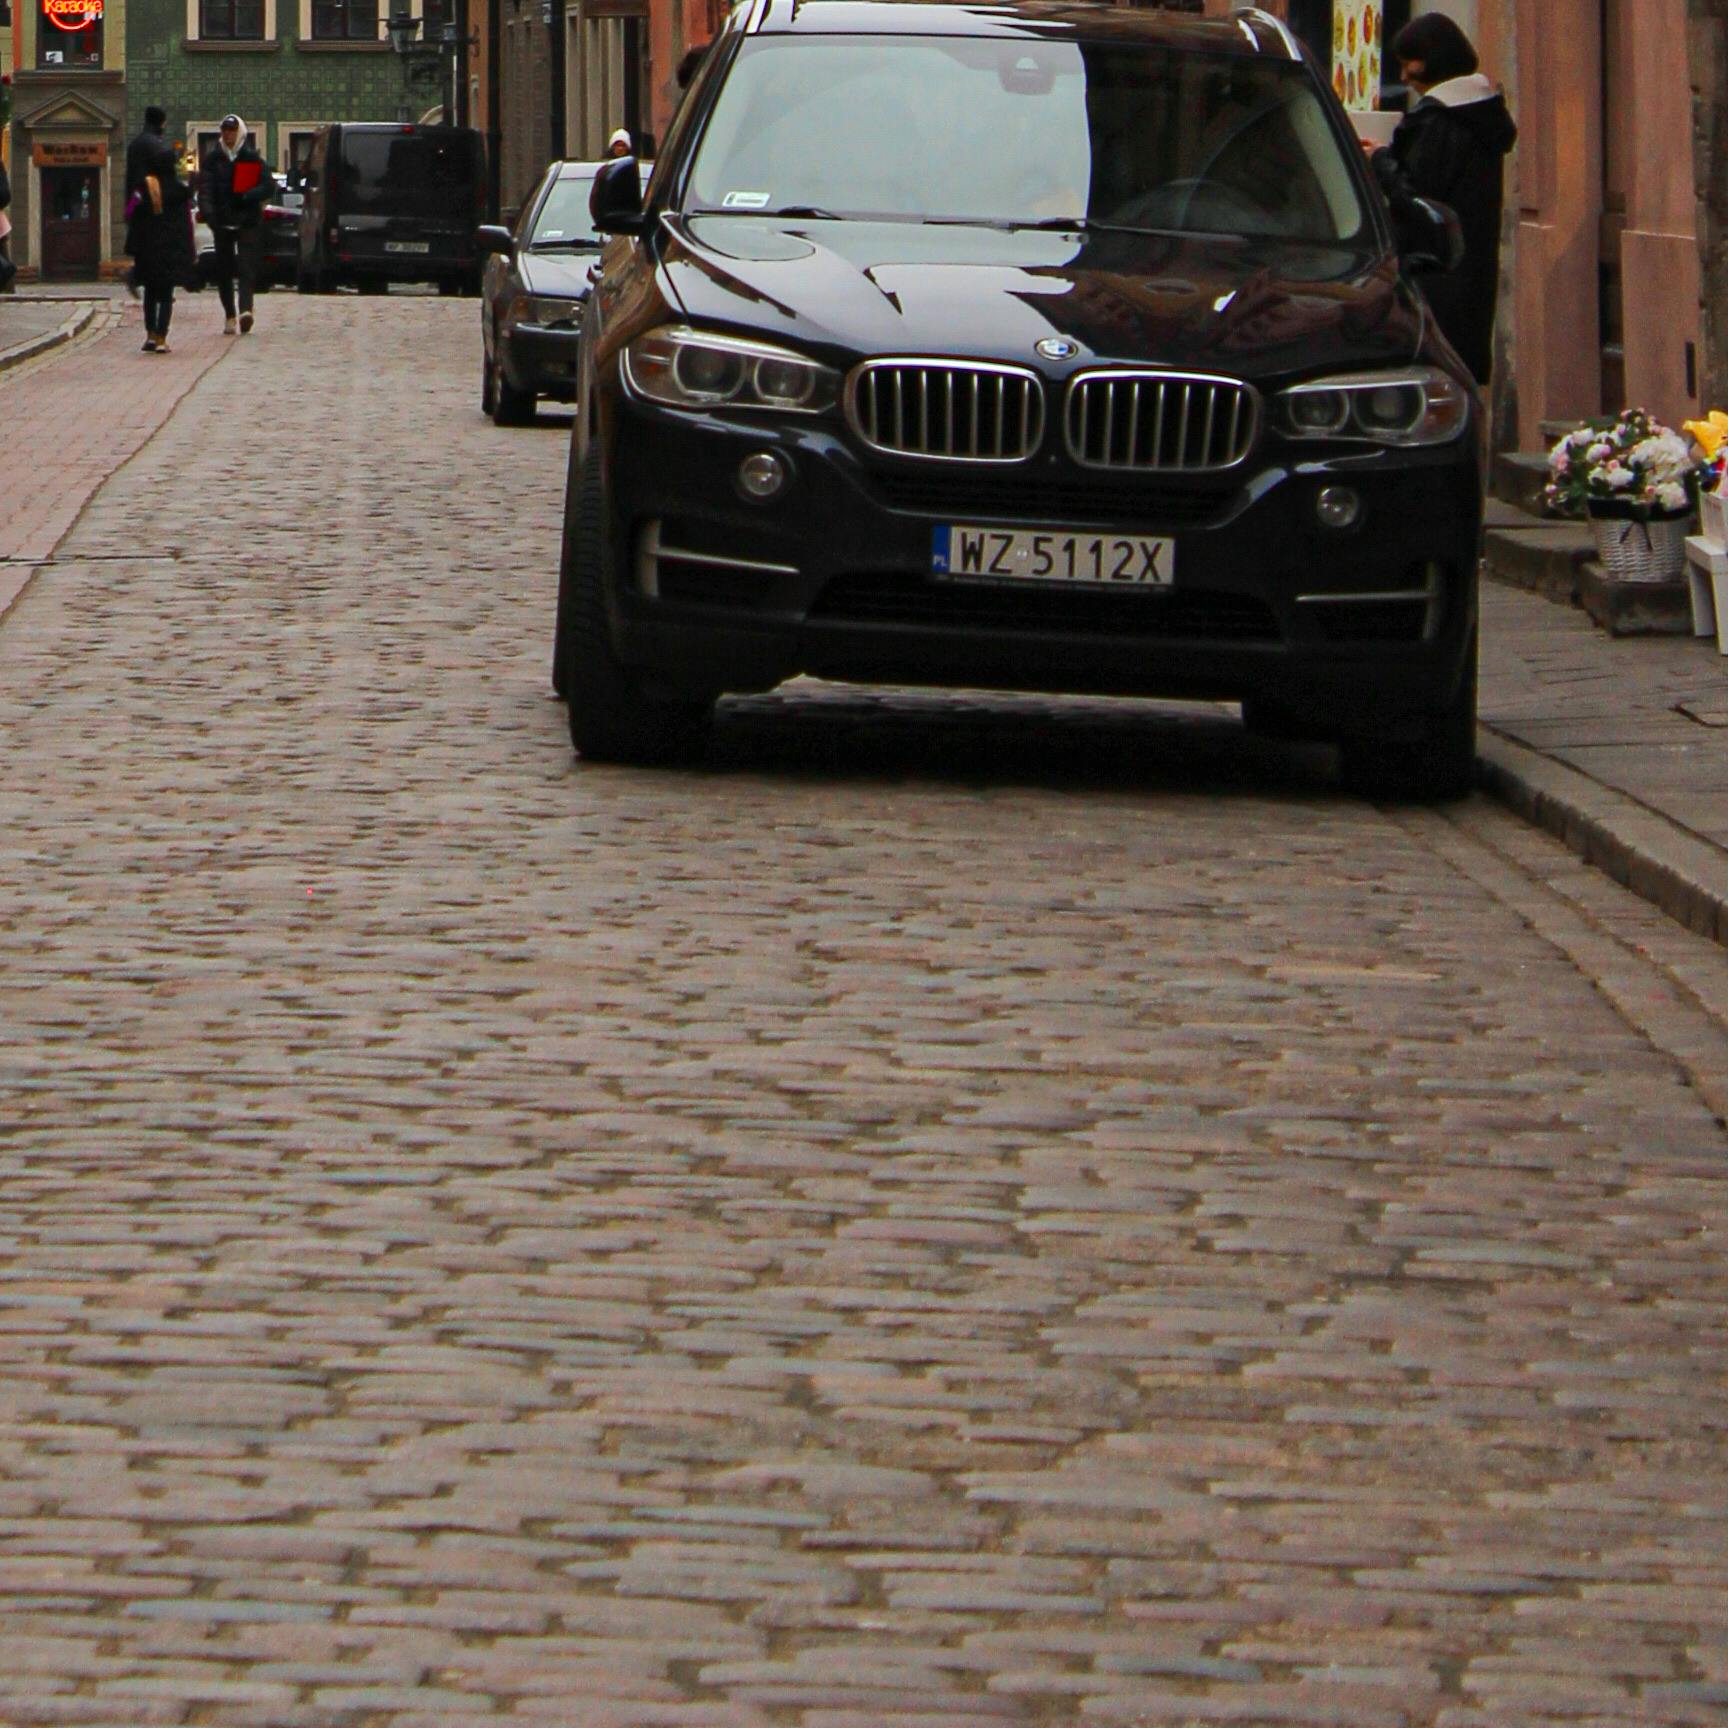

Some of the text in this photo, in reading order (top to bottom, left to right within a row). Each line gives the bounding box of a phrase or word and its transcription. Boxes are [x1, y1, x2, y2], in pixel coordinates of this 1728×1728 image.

[932, 554, 947, 567] PL
[960, 532, 1162, 582] WZ 5112X
